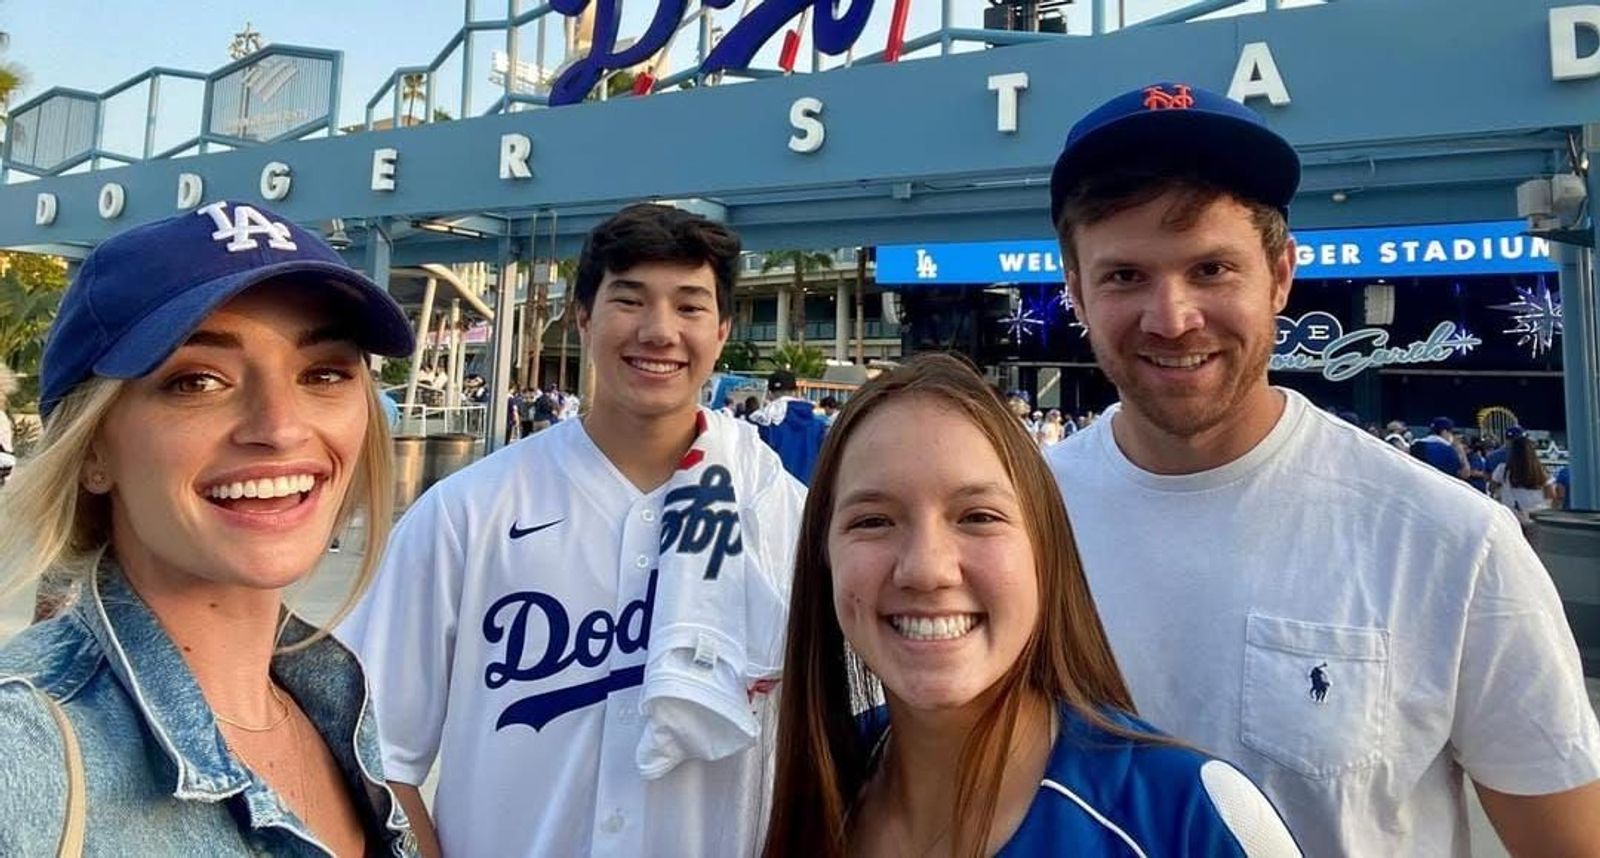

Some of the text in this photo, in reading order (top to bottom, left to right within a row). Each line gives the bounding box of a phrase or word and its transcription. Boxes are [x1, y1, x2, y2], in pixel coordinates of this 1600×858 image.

[36, 133, 533, 225] DODGER
[198, 201, 298, 252] LA
[916, 248, 938, 279] LA
[999, 252, 1064, 272] WEL
[482, 568, 659, 690] Dod
